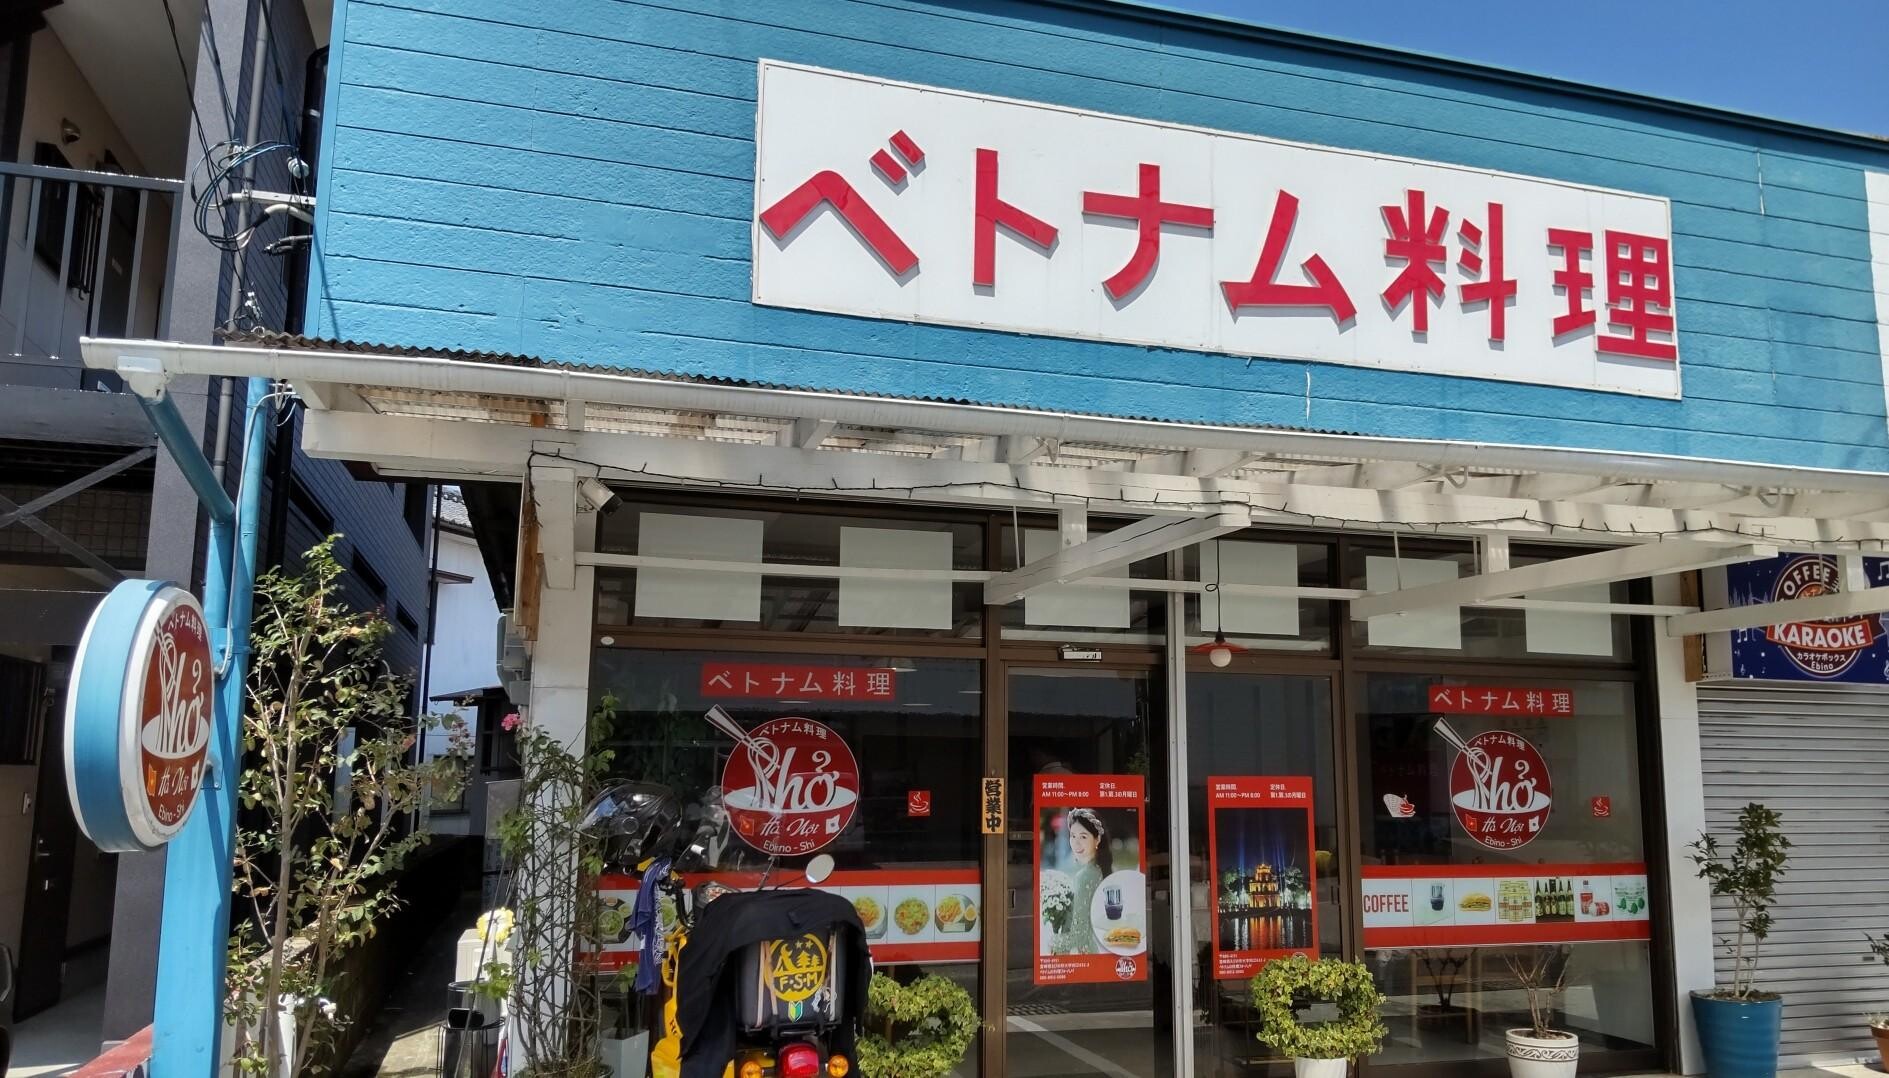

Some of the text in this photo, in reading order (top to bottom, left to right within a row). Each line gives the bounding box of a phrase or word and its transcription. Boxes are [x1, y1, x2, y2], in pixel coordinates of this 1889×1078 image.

[760, 130, 1677, 361] ベトナム料理
[1781, 565, 1831, 601] OFFEE
[1774, 624, 1866, 648] KARAOKE
[1797, 652, 1846, 662] カラオケボックス
[1811, 662, 1833, 671] Ebino
[708, 670, 890, 696] ベトナム料理
[1434, 690, 1570, 713] ベトナム料理
[759, 722, 827, 740] ベトナム料理
[1475, 735, 1526, 751] ベトナム料理
[985, 779, 1002, 833] 営業中
[1363, 894, 1409, 913] COFFEE
